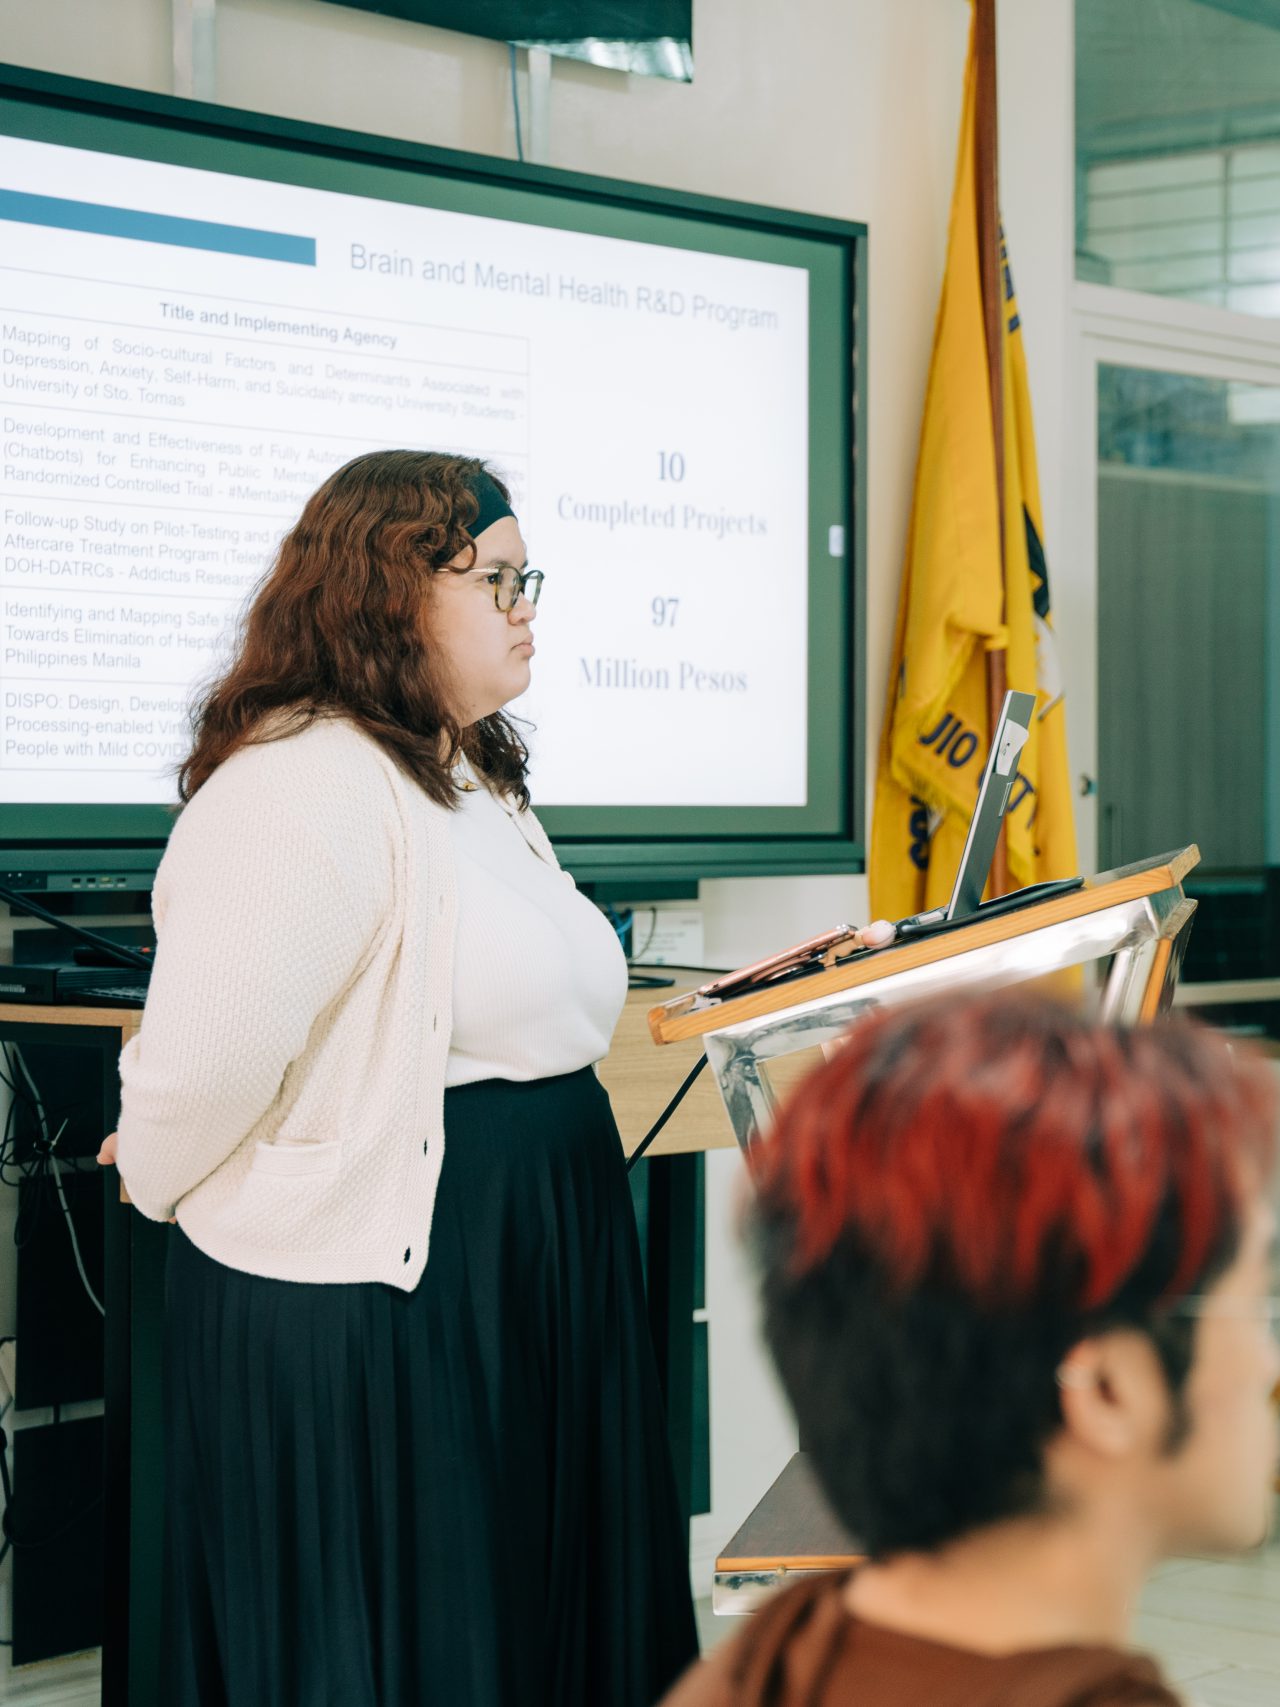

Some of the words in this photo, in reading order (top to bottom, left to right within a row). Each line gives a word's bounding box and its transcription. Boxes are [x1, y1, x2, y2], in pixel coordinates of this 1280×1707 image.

[350, 242, 413, 277] Brain
[421, 259, 466, 285] and
[474, 261, 550, 297] Mental
[558, 274, 629, 309] Health
[636, 285, 685, 317] R&D
[692, 293, 778, 331] Program
[160, 302, 195, 321] Title
[200, 311, 229, 326] and
[234, 312, 338, 342] Implementing
[343, 327, 397, 350] Agency
[2, 324, 71, 350] Mapping
[84, 336, 100, 350] of
[112, 338, 213, 364] Socio-cultural
[225, 352, 276, 372] Factors
[288, 360, 314, 376] and
[325, 364, 411, 388] Determinants
[422, 376, 490, 397] Associated
[500, 387, 525, 400] with
[2, 349, 94, 376] Depression,
[100, 361, 158, 384] Anxiety,
[164, 367, 239, 391] Self-Harm,
[245, 378, 271, 394] and
[276, 380, 344, 405] Suicidality
[348, 392, 393, 411] among
[396, 395, 458, 417] University
[461, 401, 516, 421] Students
[2, 373, 79, 399] University
[83, 382, 99, 397] of
[103, 383, 133, 401] Sto.
[137, 387, 186, 407] Tomas
[3, 417, 105, 442] Development
[113, 432, 140, 445] and
[148, 432, 243, 456] Effectiveness
[249, 443, 265, 457] of
[270, 443, 301, 464] Fully
[307, 448, 352, 464] Autom
[3, 441, 84, 467] (Chatbots)
[97, 450, 117, 466] for
[130, 453, 205, 478] Enhancing
[218, 461, 261, 479] Public
[657, 450, 686, 483] 10
[4, 465, 100, 488] Randomized
[105, 474, 180, 495] Controlled
[185, 480, 214, 497] Trial
[229, 485, 309, 504] #MentalHea
[4, 509, 79, 532] Follow-up
[84, 515, 126, 537] Study
[131, 522, 149, 535] on
[154, 520, 240, 545] Pilot-Testing
[244, 530, 270, 543] and
[557, 492, 675, 532] Completed
[682, 504, 768, 541] Projects
[4, 533, 74, 553] Aftercare
[79, 538, 154, 558] Treatment
[158, 544, 219, 564] Program
[224, 548, 268, 565] (Teleh
[4, 556, 114, 579] DOH-DATRCs
[128, 565, 191, 583] Addictus
[195, 569, 257, 586] Researc
[5, 601, 82, 623] Identifying
[88, 608, 115, 622] and
[120, 608, 182, 629] Mapping
[187, 610, 219, 627] Safe
[651, 595, 681, 628] 97
[5, 624, 69, 643] Towards
[74, 627, 154, 647] Elimination
[159, 632, 173, 647] of
[5, 648, 88, 668] Philippines
[93, 652, 141, 668] Manila
[578, 656, 670, 689] Million
[678, 660, 749, 693] Pesos
[5, 692, 63, 710] DISPO:
[68, 694, 124, 714] Design,
[130, 695, 190, 715] Develop
[5, 716, 153, 736] Processing-enabled
[5, 740, 59, 759] People
[64, 741, 93, 756] with
[98, 741, 129, 757] Mild
